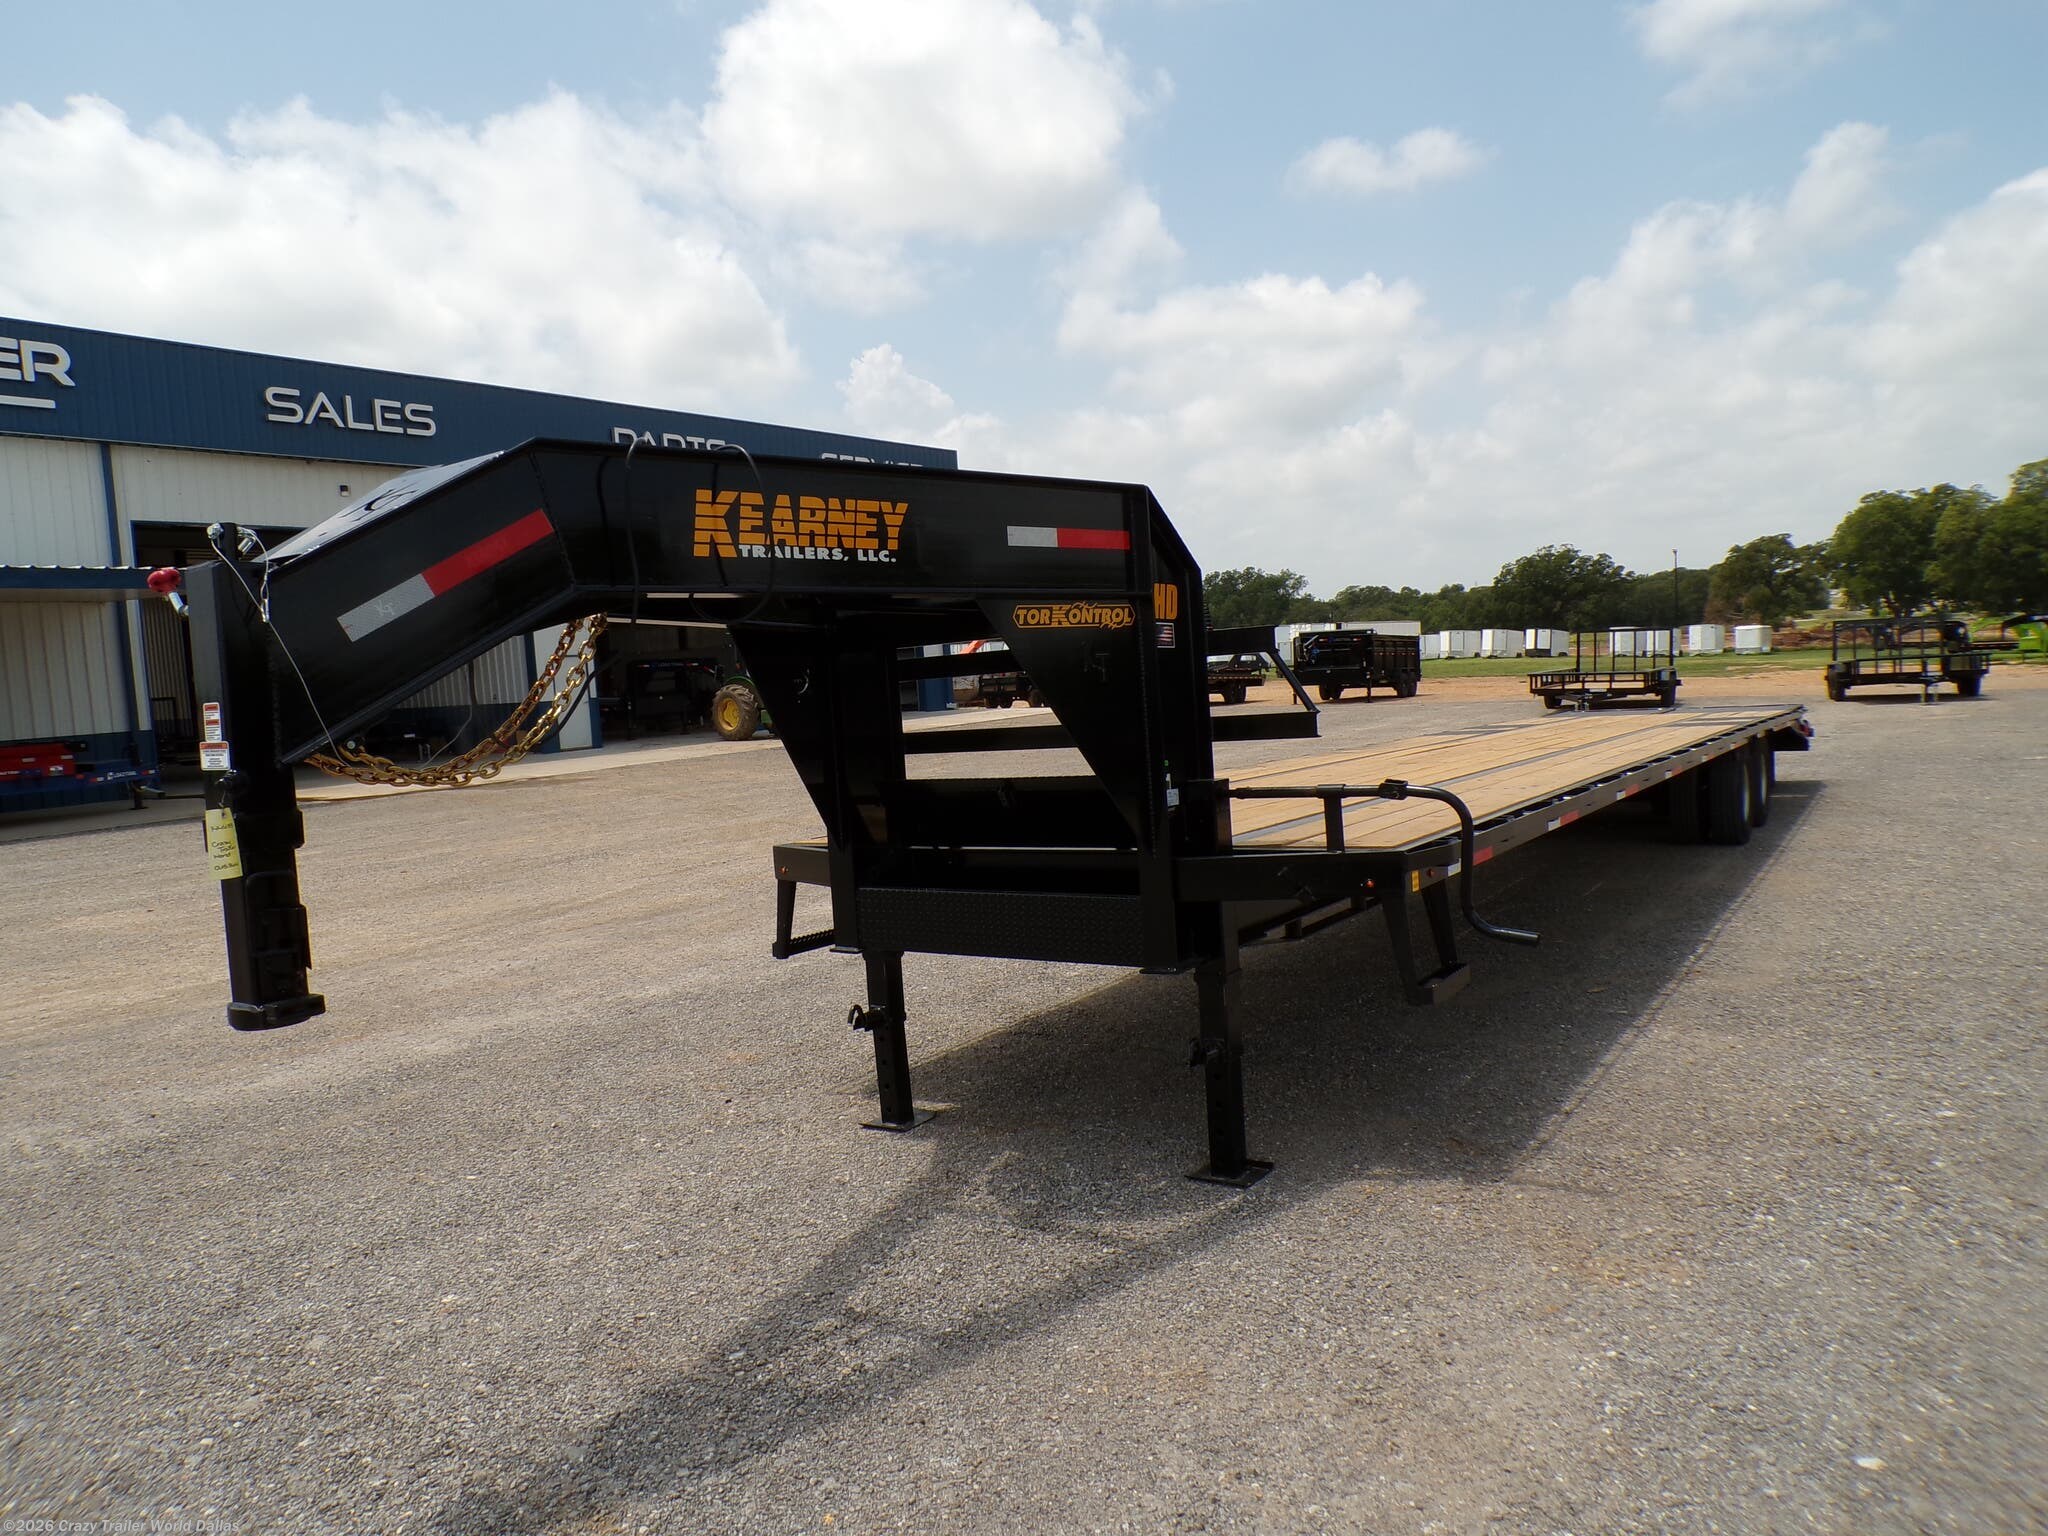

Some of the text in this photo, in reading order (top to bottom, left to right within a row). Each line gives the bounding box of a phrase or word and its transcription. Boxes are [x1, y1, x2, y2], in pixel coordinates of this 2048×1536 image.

[264, 386, 437, 437] SALES
[693, 488, 909, 558] KEARNEY
[738, 544, 897, 563] TRAILERS, LLC.
[1015, 604, 1132, 627] TORKONTROL
[1153, 583, 1178, 620] HD
